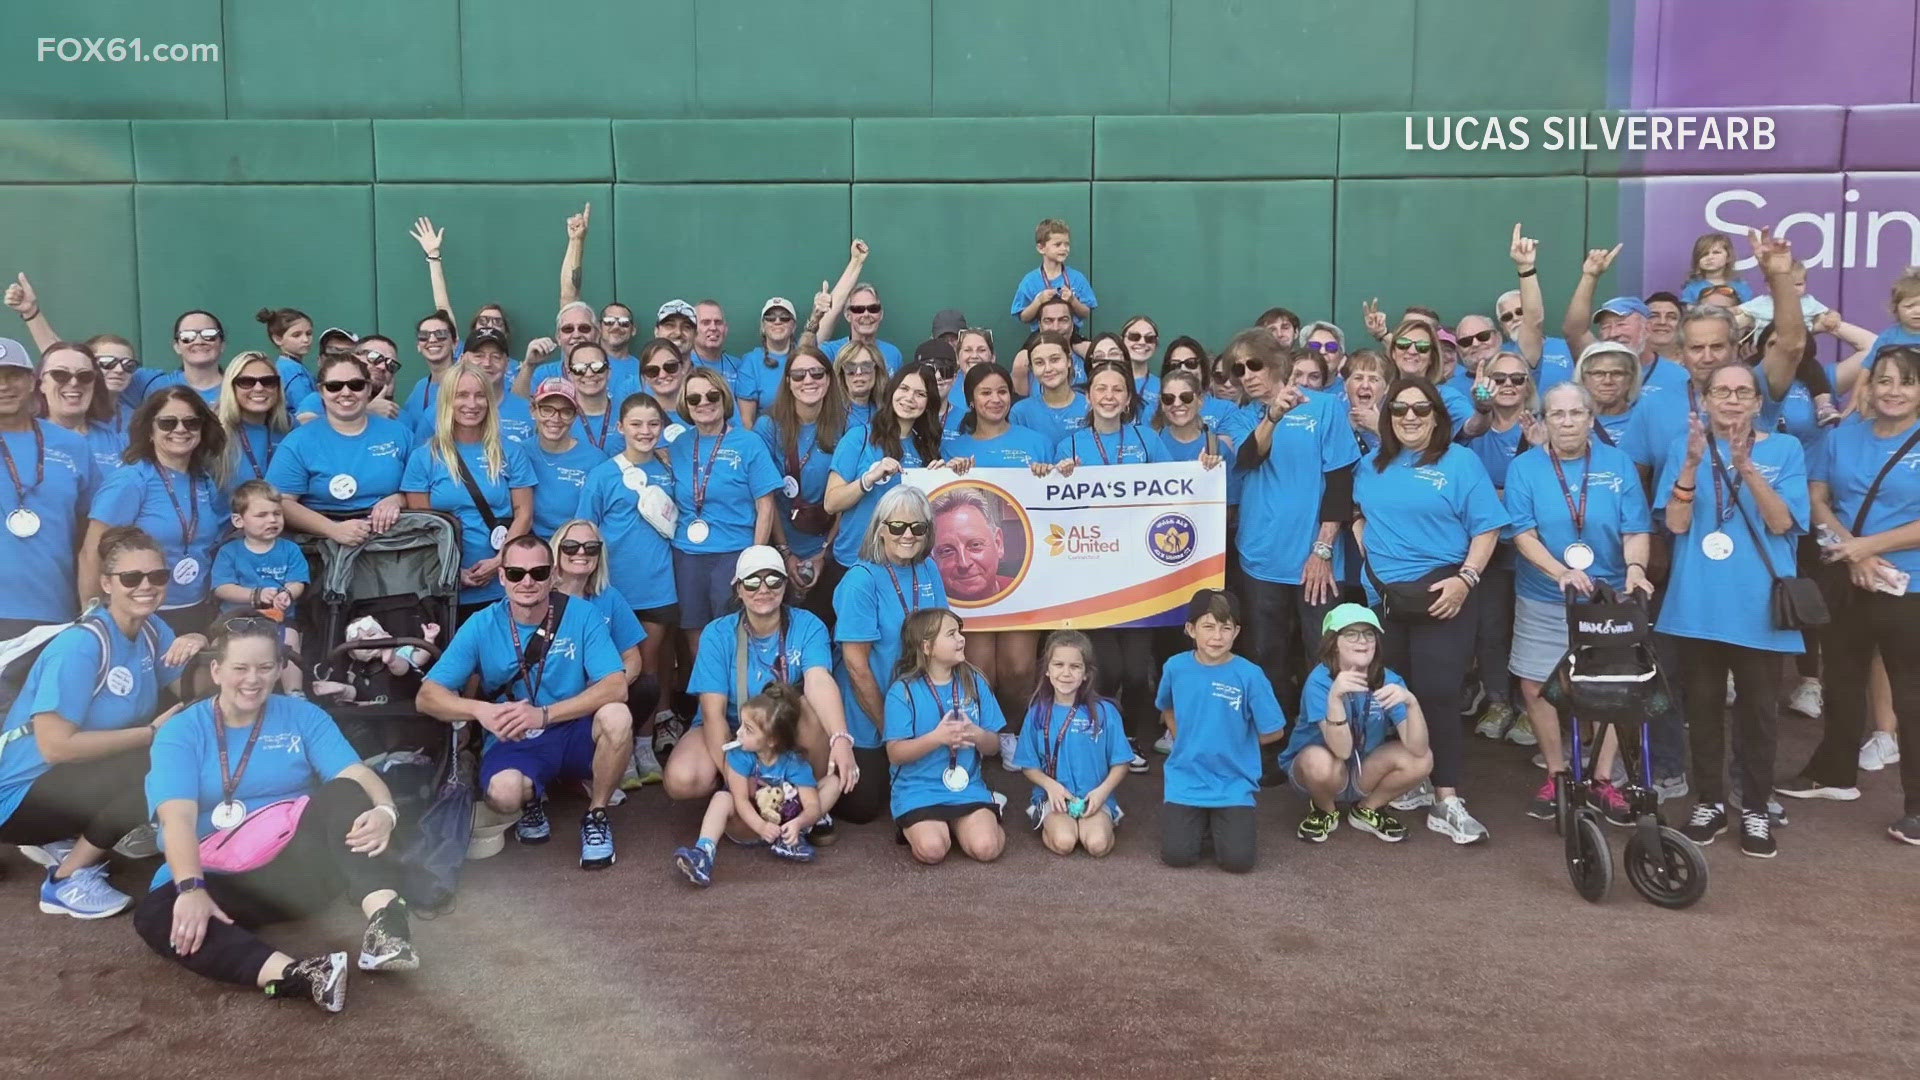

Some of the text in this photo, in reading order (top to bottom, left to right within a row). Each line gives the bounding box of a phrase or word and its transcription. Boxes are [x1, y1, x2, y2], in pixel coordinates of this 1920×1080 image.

[1046, 478, 1194, 501] PAPA'S PACK
[1068, 525, 1101, 539] ALS
[1067, 538, 1120, 553] United
